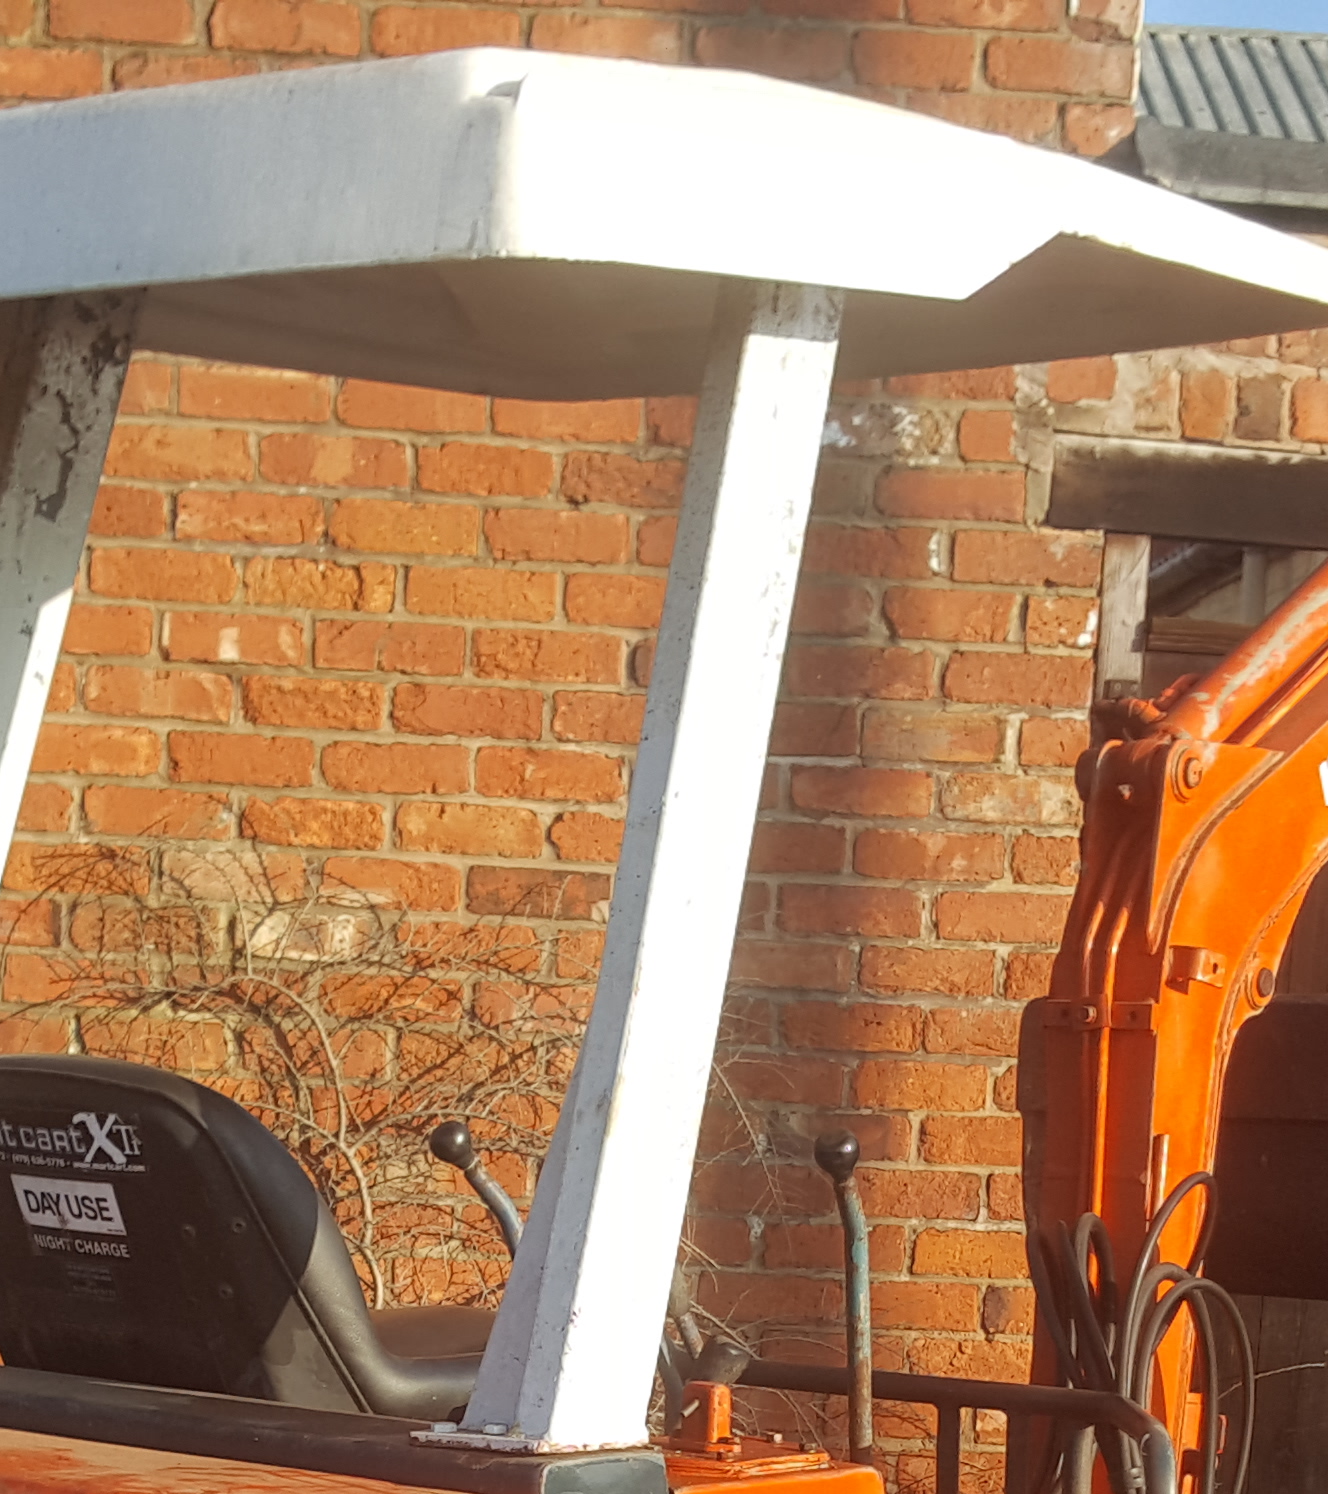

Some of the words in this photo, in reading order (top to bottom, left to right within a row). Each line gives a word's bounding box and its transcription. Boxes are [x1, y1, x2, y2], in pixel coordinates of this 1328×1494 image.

[23, 1189, 62, 1217] DAY
[64, 1194, 114, 1222] USE
[33, 1233, 71, 1252] NIGHT
[74, 1239, 130, 1258] CHARGE
